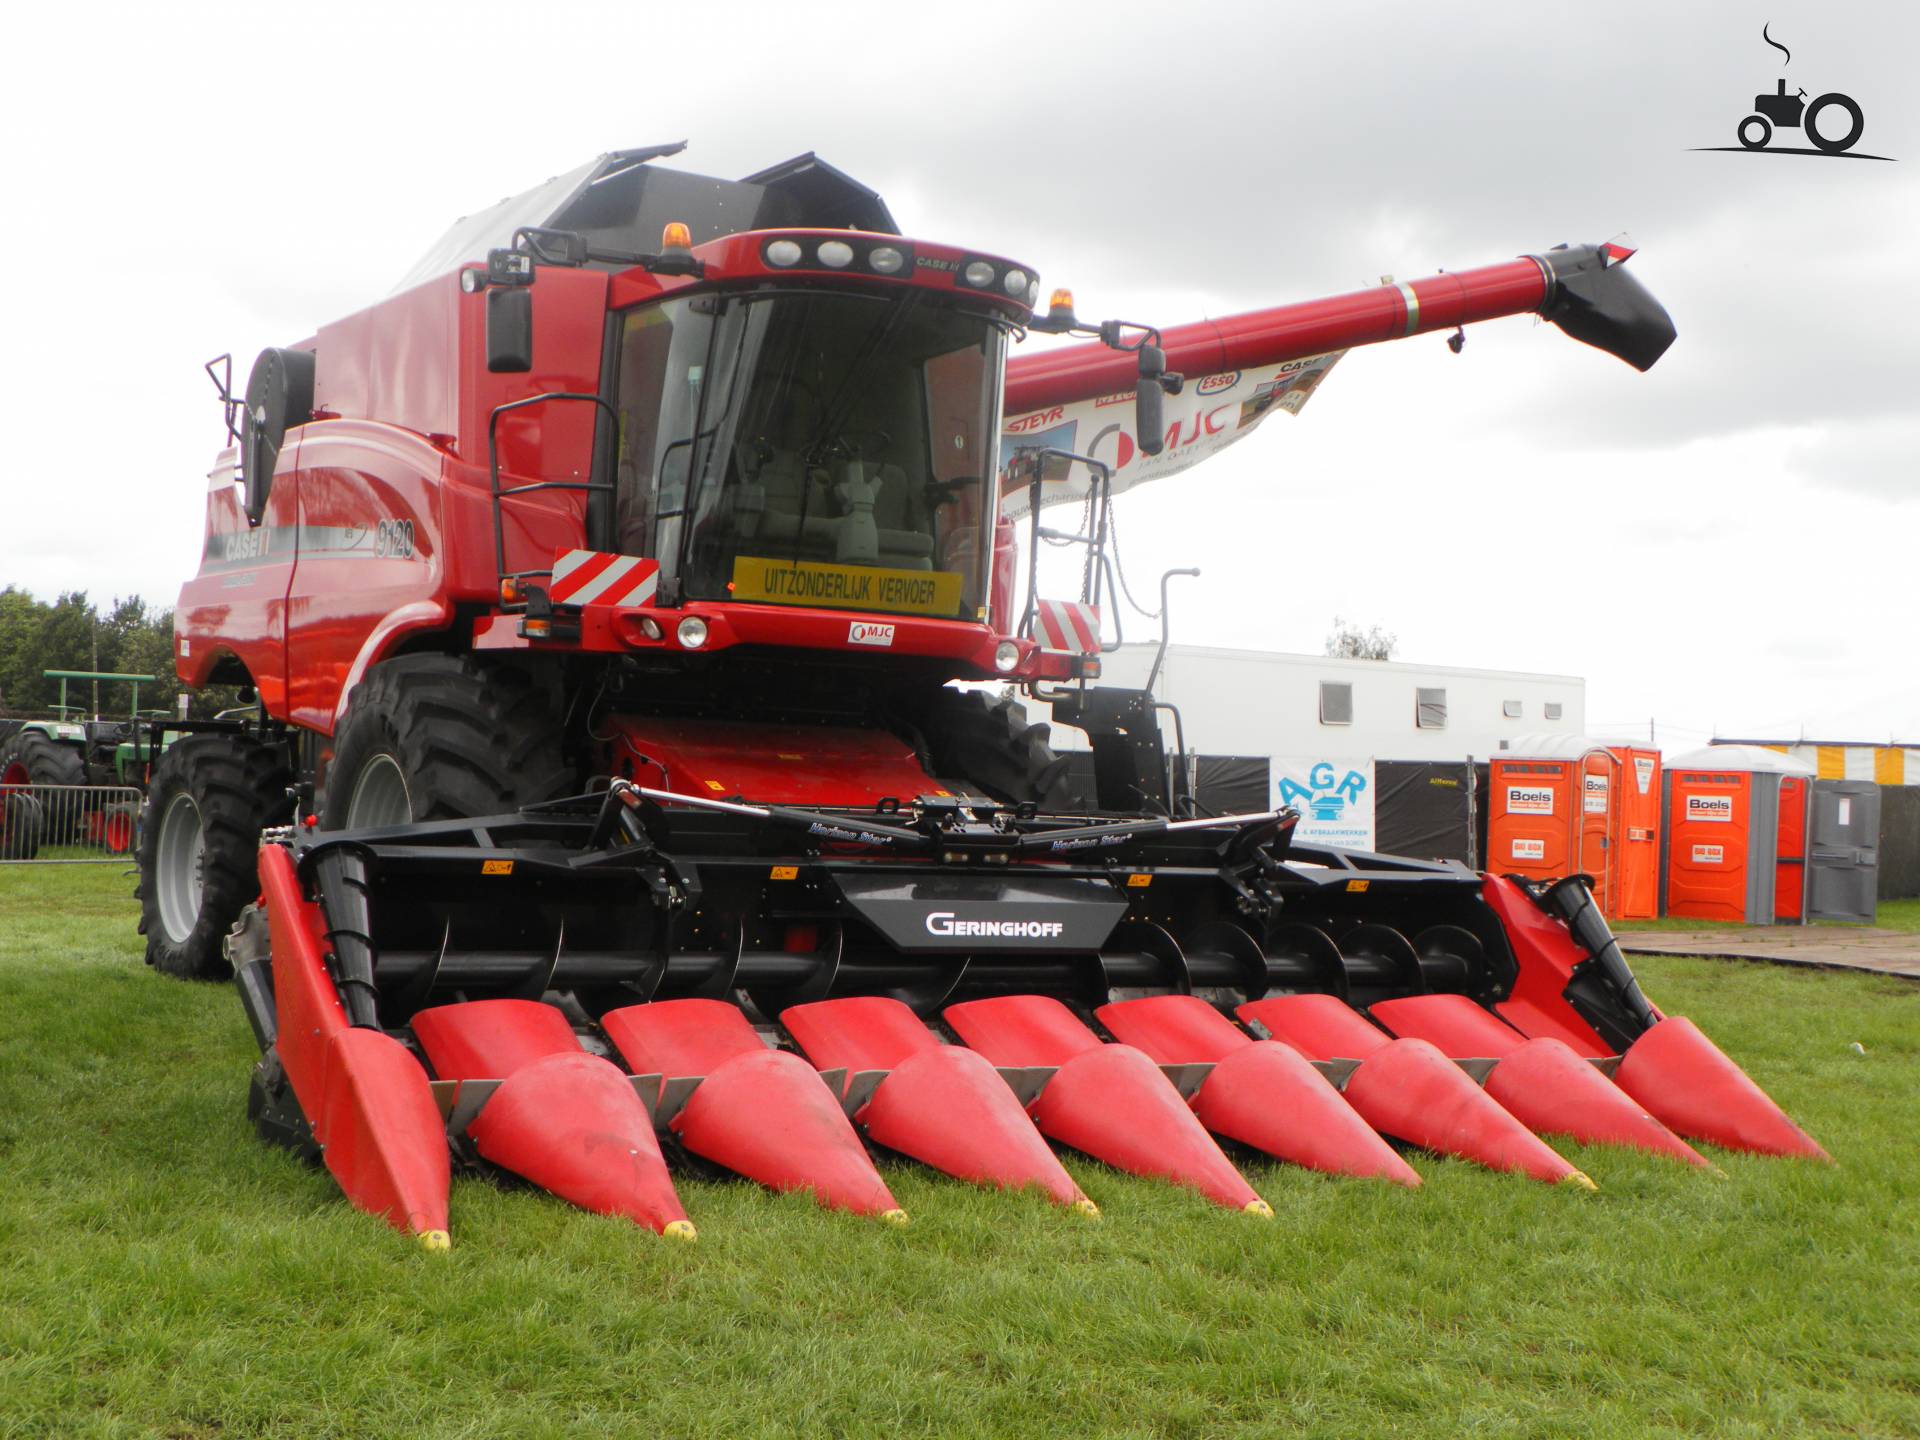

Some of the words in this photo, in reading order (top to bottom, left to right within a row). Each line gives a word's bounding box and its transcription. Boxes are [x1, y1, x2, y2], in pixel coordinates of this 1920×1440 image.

[916, 257, 948, 270] CASE
[1202, 373, 1235, 390] ESSO
[1004, 405, 1065, 432] STEYR
[225, 532, 258, 562] CASE
[376, 518, 415, 559] 9120
[764, 567, 871, 601] UITZONDERLIJK
[878, 577, 936, 605] VERVOER
[867, 625, 893, 638] MJC
[1278, 761, 1367, 806] AGR
[1510, 790, 1552, 802] Boels
[1690, 799, 1729, 809] Boels
[926, 912, 1063, 937] GERINGHOFF
